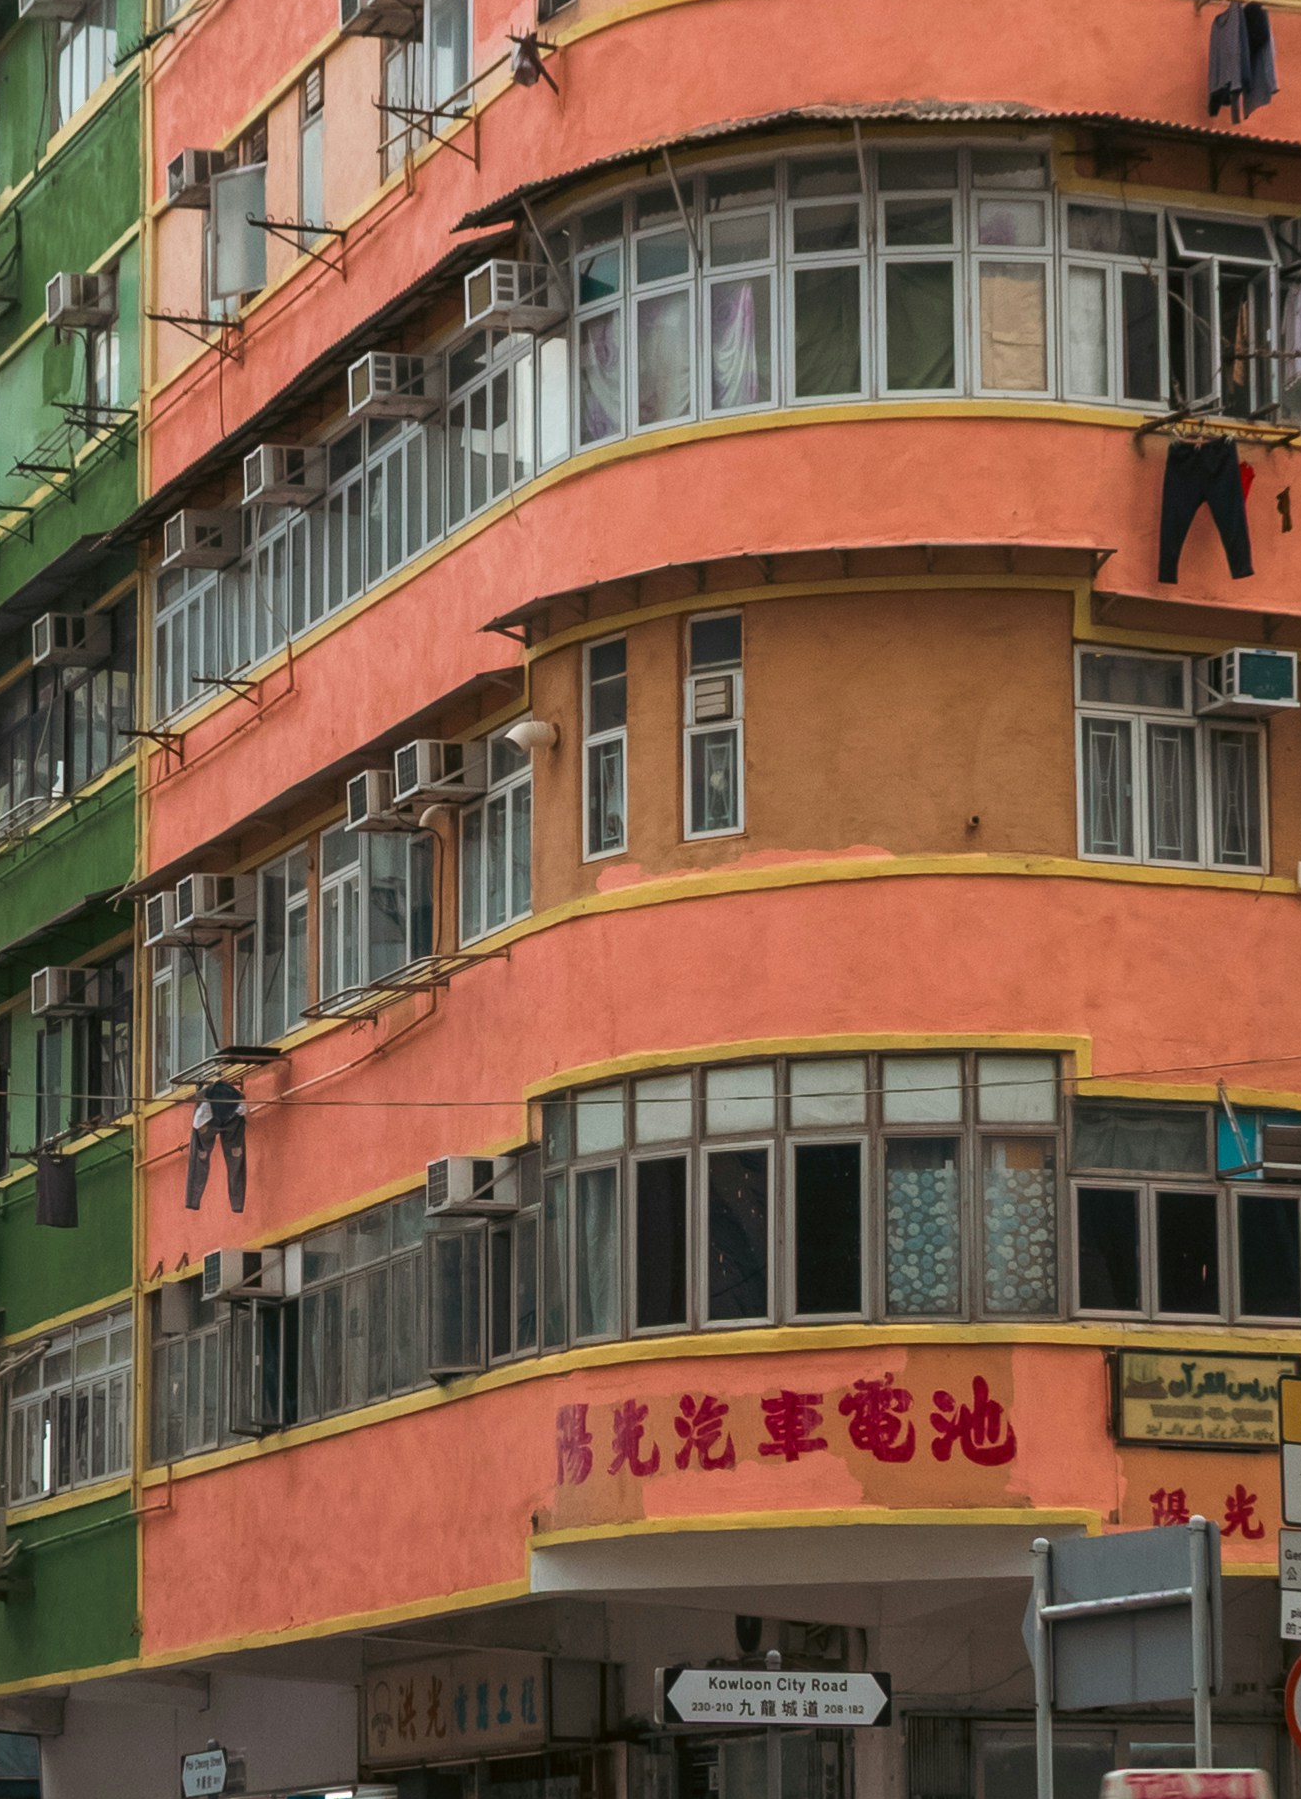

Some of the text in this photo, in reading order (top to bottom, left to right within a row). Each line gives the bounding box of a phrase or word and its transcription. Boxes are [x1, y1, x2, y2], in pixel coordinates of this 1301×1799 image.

[555, 1372, 1018, 1487] 陽光汽車電池
[708, 1677, 848, 1694] Kowloon City Road
[739, 1699, 819, 1718] 九龍城道
